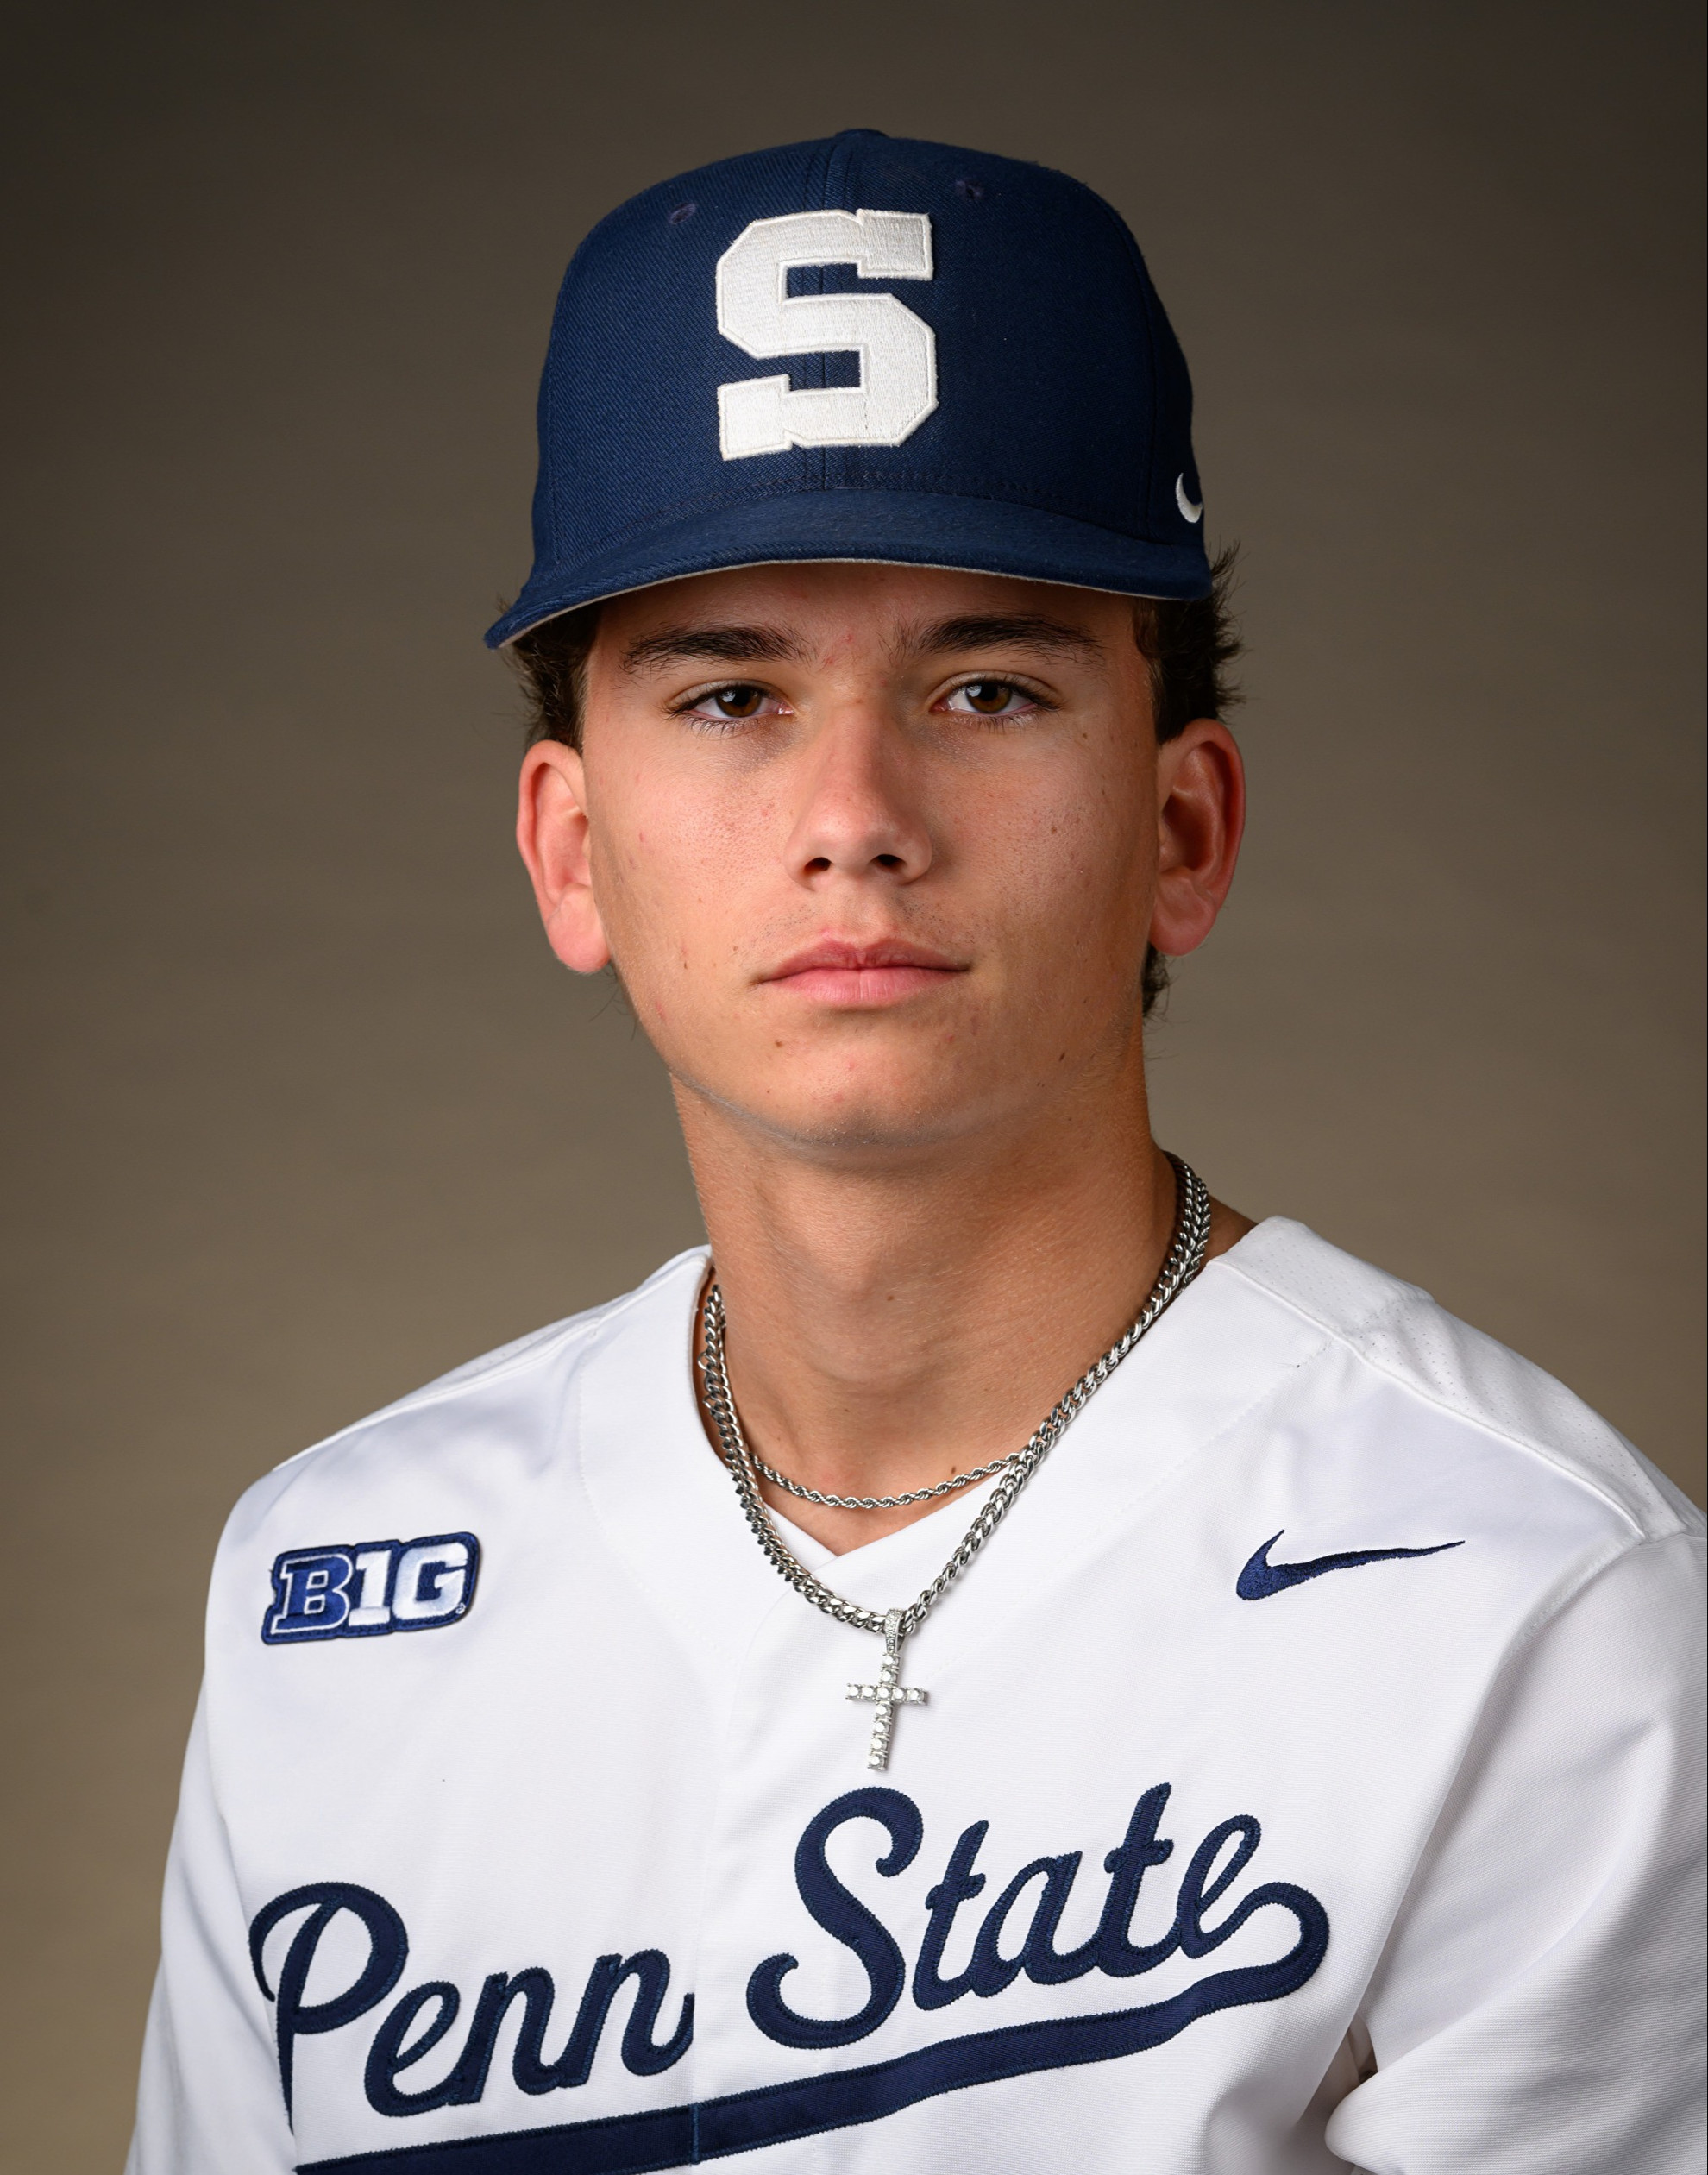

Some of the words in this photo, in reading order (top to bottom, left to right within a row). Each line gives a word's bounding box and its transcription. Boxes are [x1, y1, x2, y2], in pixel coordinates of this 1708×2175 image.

[715, 209, 939, 461] S
[248, 1882, 694, 2134] Penn
[746, 1782, 1330, 2050] State
